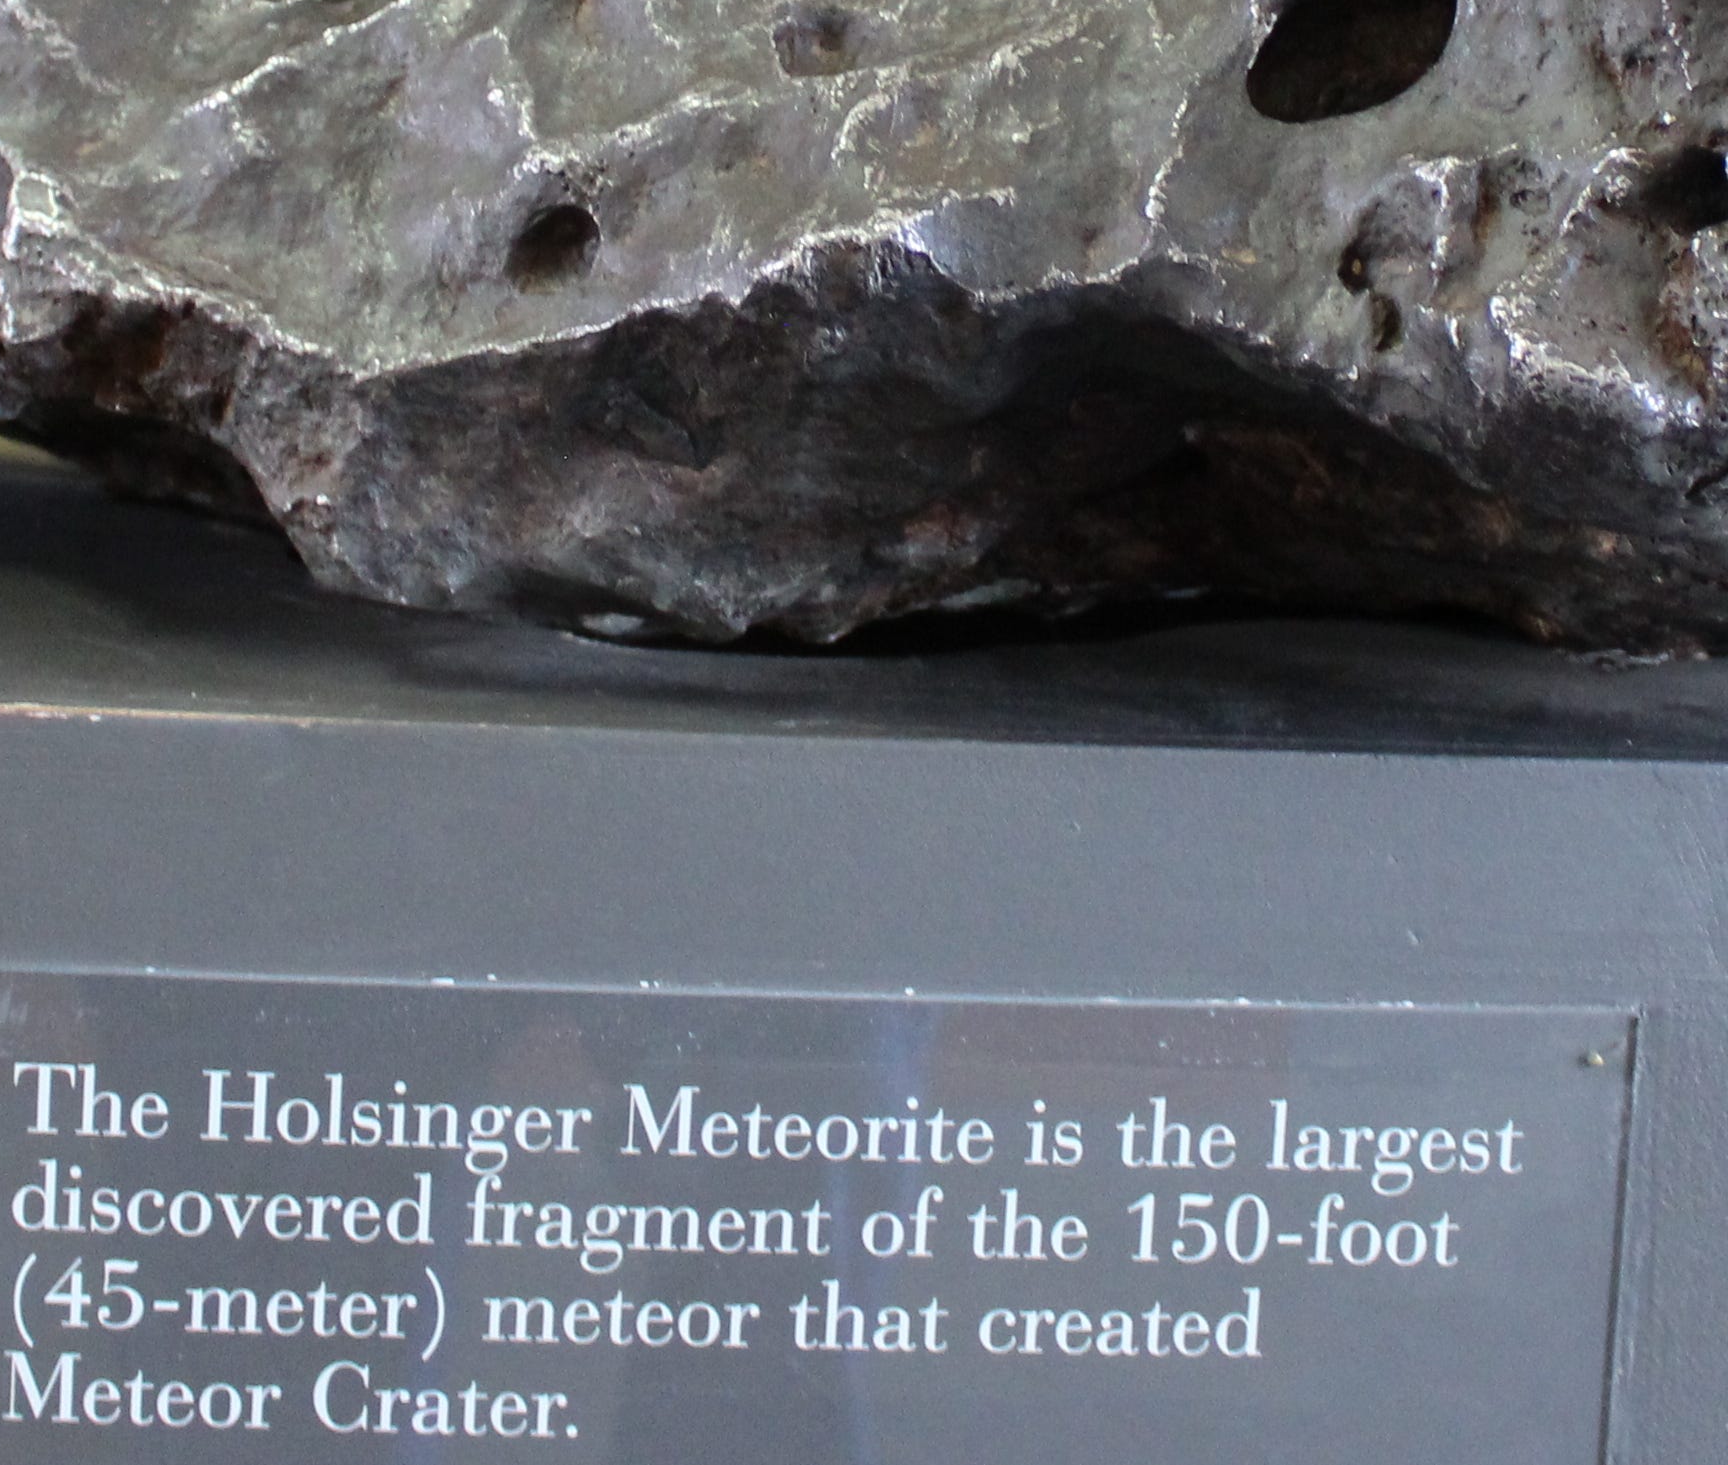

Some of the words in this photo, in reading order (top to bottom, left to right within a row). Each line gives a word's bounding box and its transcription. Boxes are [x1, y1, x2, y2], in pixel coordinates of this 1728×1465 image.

[14, 1062, 169, 1140] The
[199, 1069, 593, 1174] Holsinger
[620, 1083, 995, 1166] Meteorite
[1024, 1098, 1084, 1166] is
[1116, 1096, 1237, 1170] the
[1265, 1098, 1524, 1197] largest
[11, 1158, 435, 1245] discovered
[464, 1172, 832, 1275] fragment
[861, 1184, 944, 1258] of
[966, 1187, 1089, 1262] the
[1127, 1192, 1460, 1267] 150-foot
[13, 1252, 446, 1363] (45-meter)
[481, 1290, 761, 1349] meteor
[788, 1278, 949, 1354] that
[978, 1286, 1262, 1360] created
[1, 1349, 283, 1430] Meteor
[312, 1360, 579, 1439] Crater.
